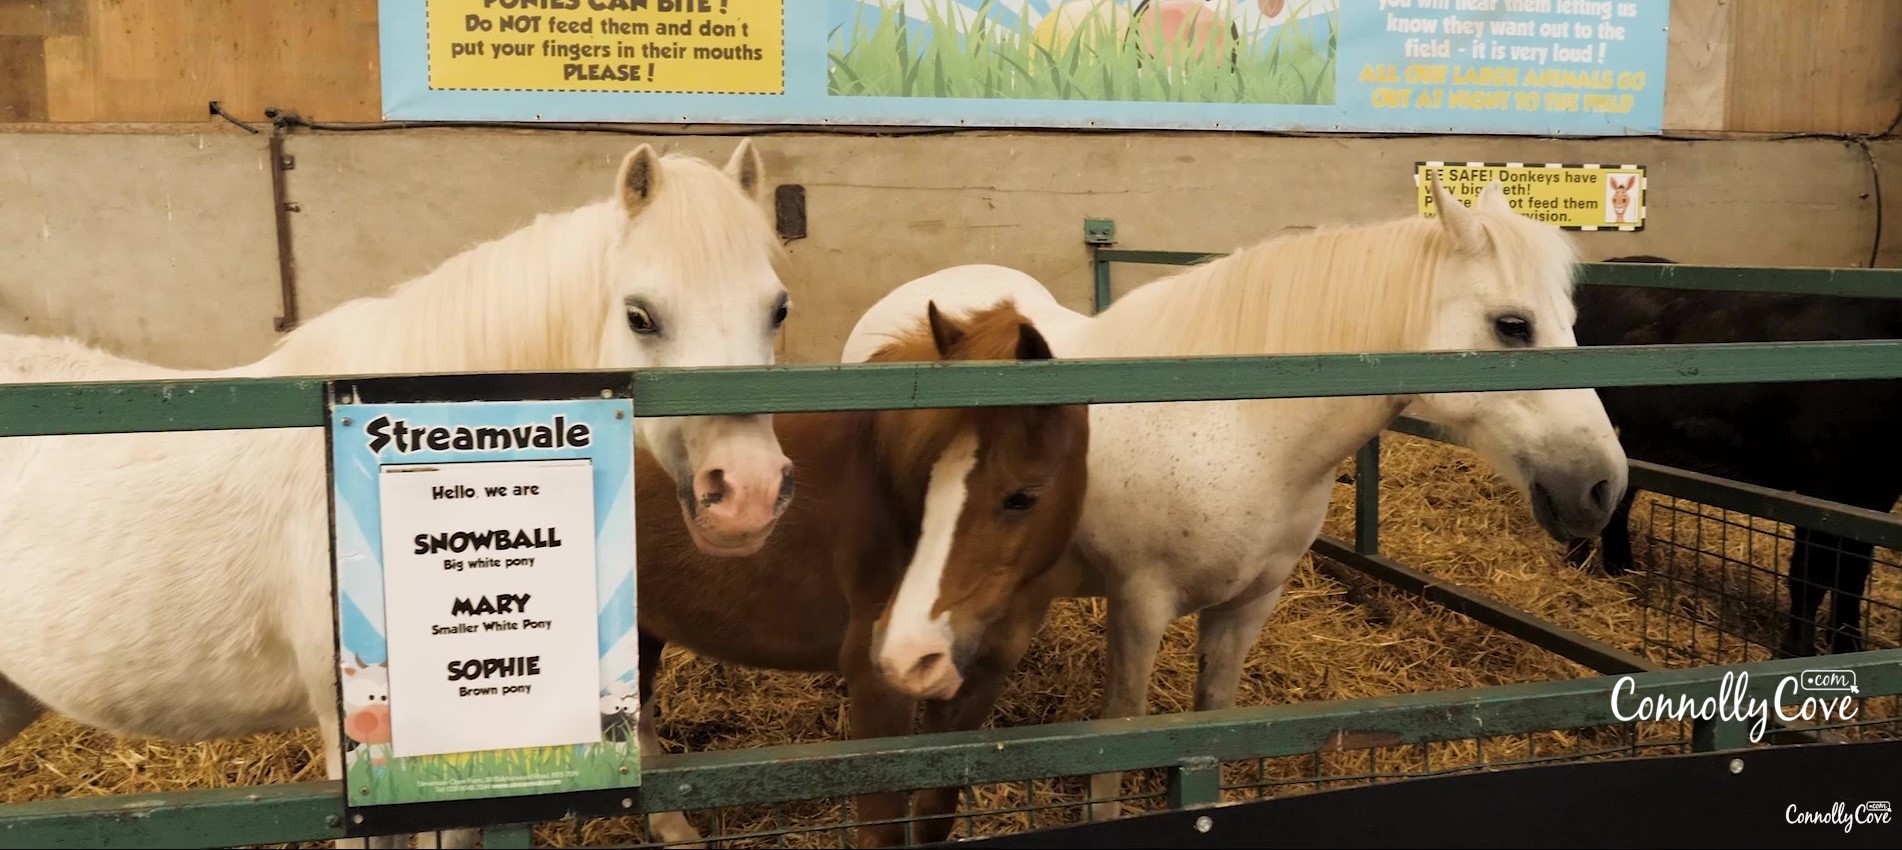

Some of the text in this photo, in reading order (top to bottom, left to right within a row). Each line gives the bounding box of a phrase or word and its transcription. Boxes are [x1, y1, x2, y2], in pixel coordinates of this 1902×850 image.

[1617, 2, 1637, 17] us
[465, 14, 493, 32] Do
[499, 15, 541, 33] NOT
[548, 17, 593, 34] feed
[600, 18, 649, 35] them
[656, 20, 692, 36] and
[1386, 12, 1625, 41] know they want out to the
[451, 40, 763, 60] put your fingers in their mouths
[1404, 38, 1450, 57] field
[1472, 40, 1486, 59] it
[1491, 40, 1506, 60] is
[1510, 46, 1548, 65] very
[1358, 63, 1647, 91] ALL OUR LARGE ANIMALS GO
[1372, 87, 1635, 113] OUT AT NIGHT TO THE FIELD
[1449, 169, 1493, 182] SAFE!
[1499, 170, 1560, 185] Donkeys
[1565, 171, 1597, 183] have
[1509, 197, 1598, 209] ot feed them
[366, 416, 590, 453] Streamvale
[485, 486, 507, 498] we
[513, 484, 540, 496] are
[414, 527, 562, 555] SNOWBALL
[444, 556, 535, 571] Big white pony
[452, 593, 531, 616] MARY
[431, 618, 552, 635] Smaller White Pony
[447, 655, 541, 682] SOPHIE
[459, 682, 532, 697] Brown pony
